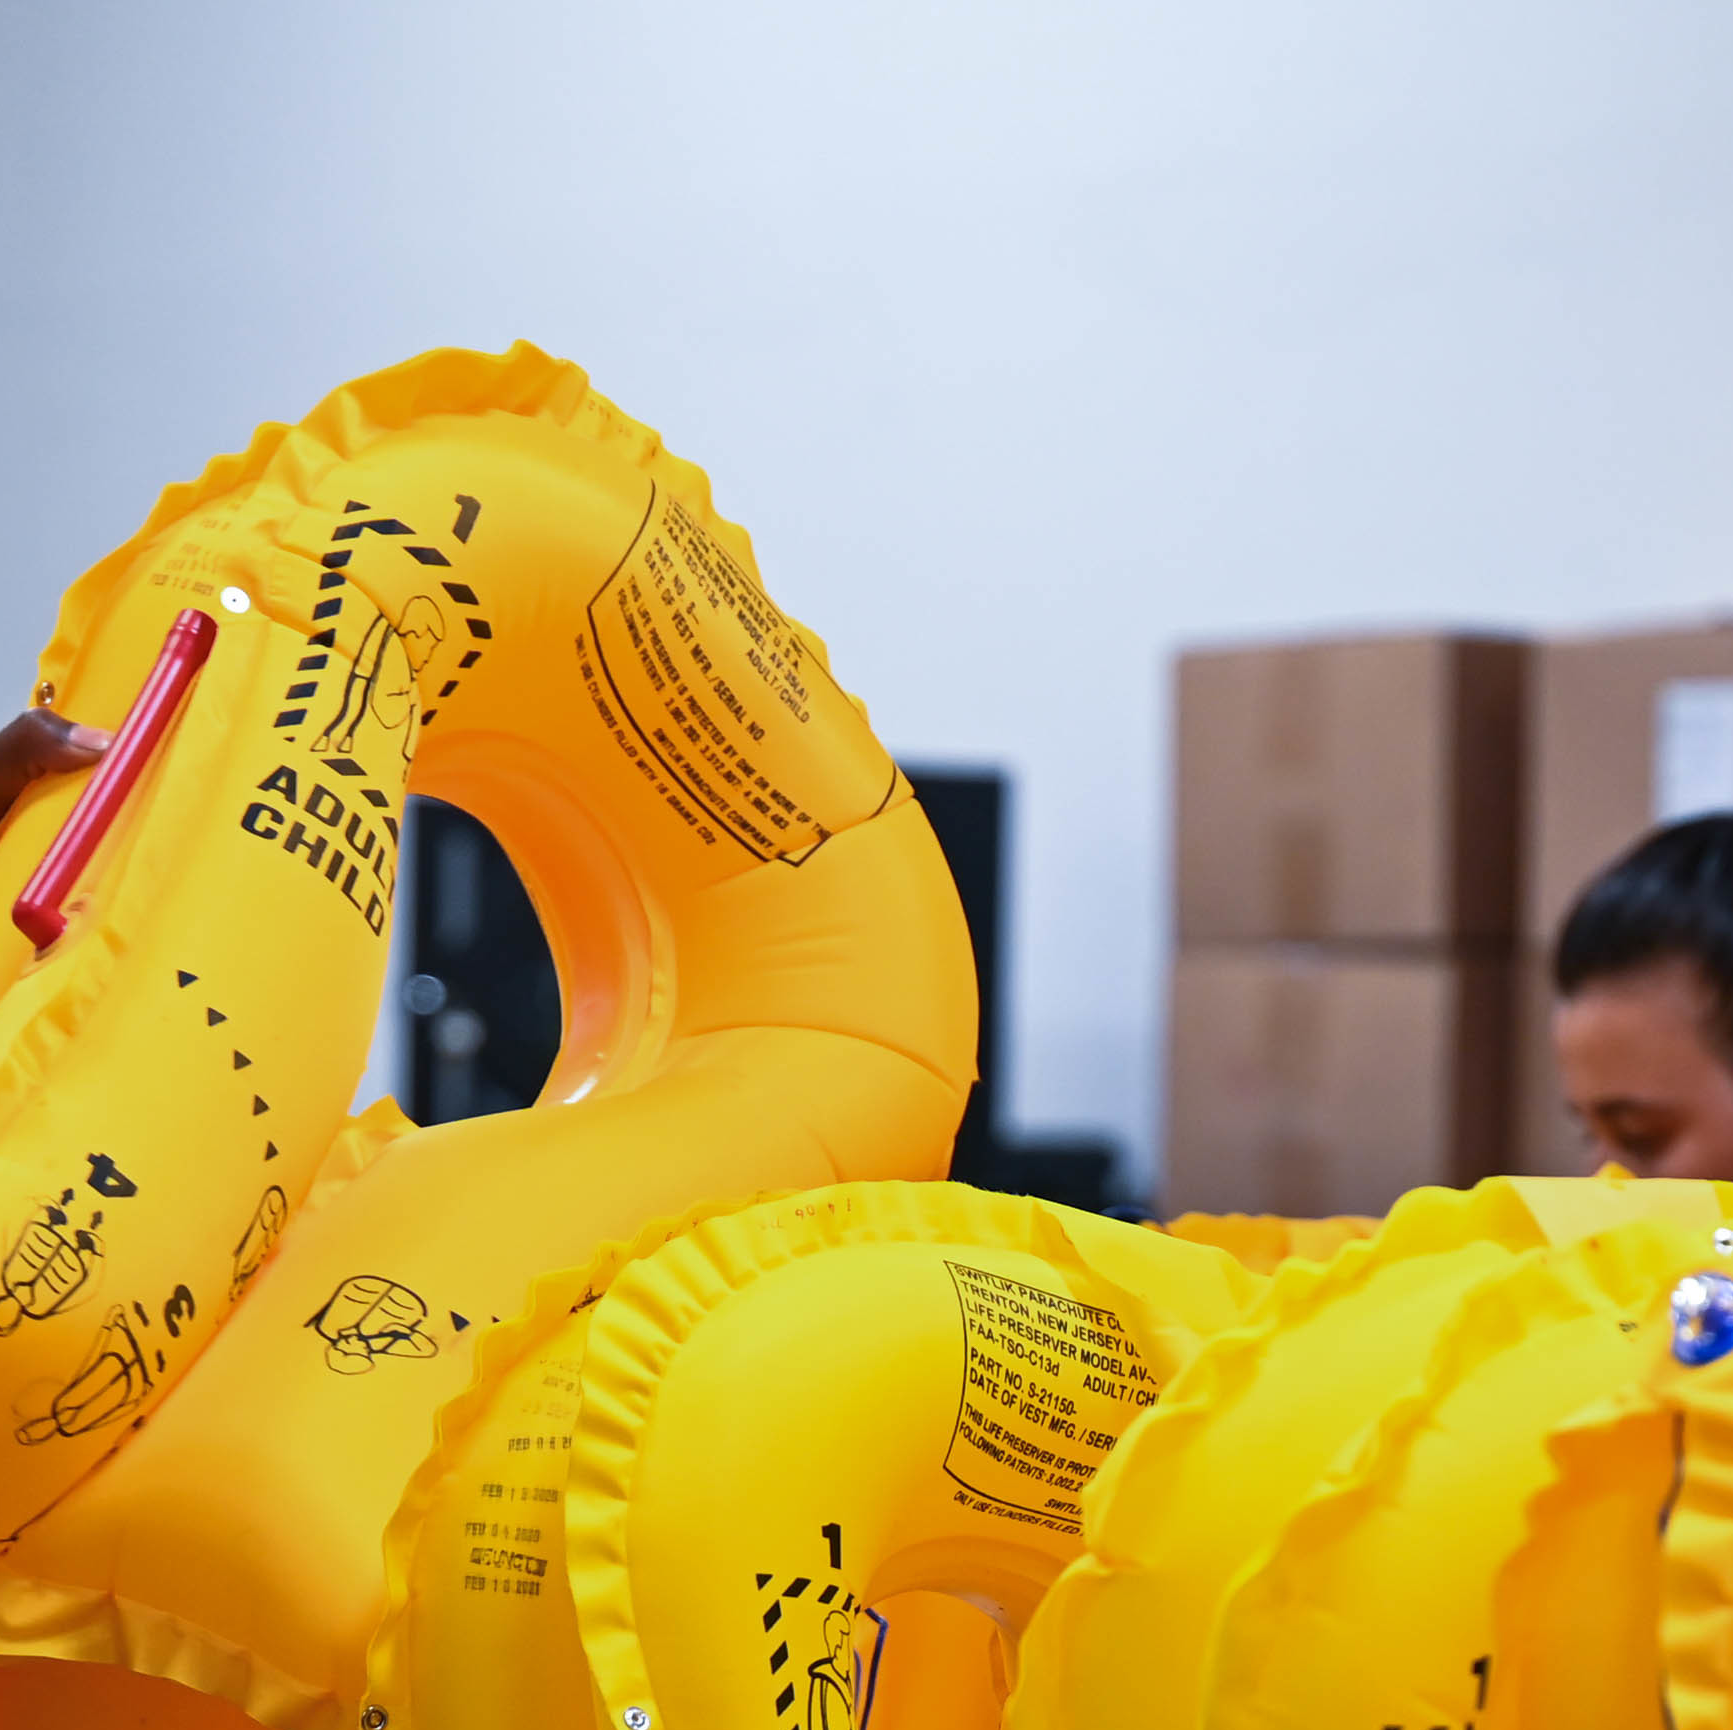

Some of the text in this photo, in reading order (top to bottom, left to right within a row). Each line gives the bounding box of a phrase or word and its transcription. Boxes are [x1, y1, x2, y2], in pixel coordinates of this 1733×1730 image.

[452, 493, 482, 545] 1
[240, 802, 385, 937] CHILD
[87, 1152, 139, 1198] 4
[163, 1283, 196, 1339] 3
[954, 1264, 1018, 1296] SWITLIK
[1019, 1285, 1105, 1328] PARACHUTE
[964, 1297, 996, 1324] LIFE
[998, 1315, 1078, 1361] PRESERVER
[1080, 1347, 1126, 1378] MODEL
[1037, 1312, 1068, 1334] NEW
[1070, 1322, 1123, 1354] JERSEY
[970, 1346, 1003, 1377] PART
[969, 1367, 1000, 1401] DATE
[1000, 1389, 1018, 1410] OF
[1018, 1399, 1050, 1427] VEST
[1047, 1414, 1076, 1441] MFG.
[1082, 1373, 1127, 1403] ADULT
[958, 1420, 1005, 1462] FOLLOWING
[964, 1401, 983, 1427] THIS
[982, 1417, 1004, 1440] LIFE
[1001, 1430, 1056, 1466] PRESERVER
[1053, 1455, 1068, 1470] IS
[820, 1522, 844, 1570] 1
[1039, 1518, 1081, 1536] FILLED
